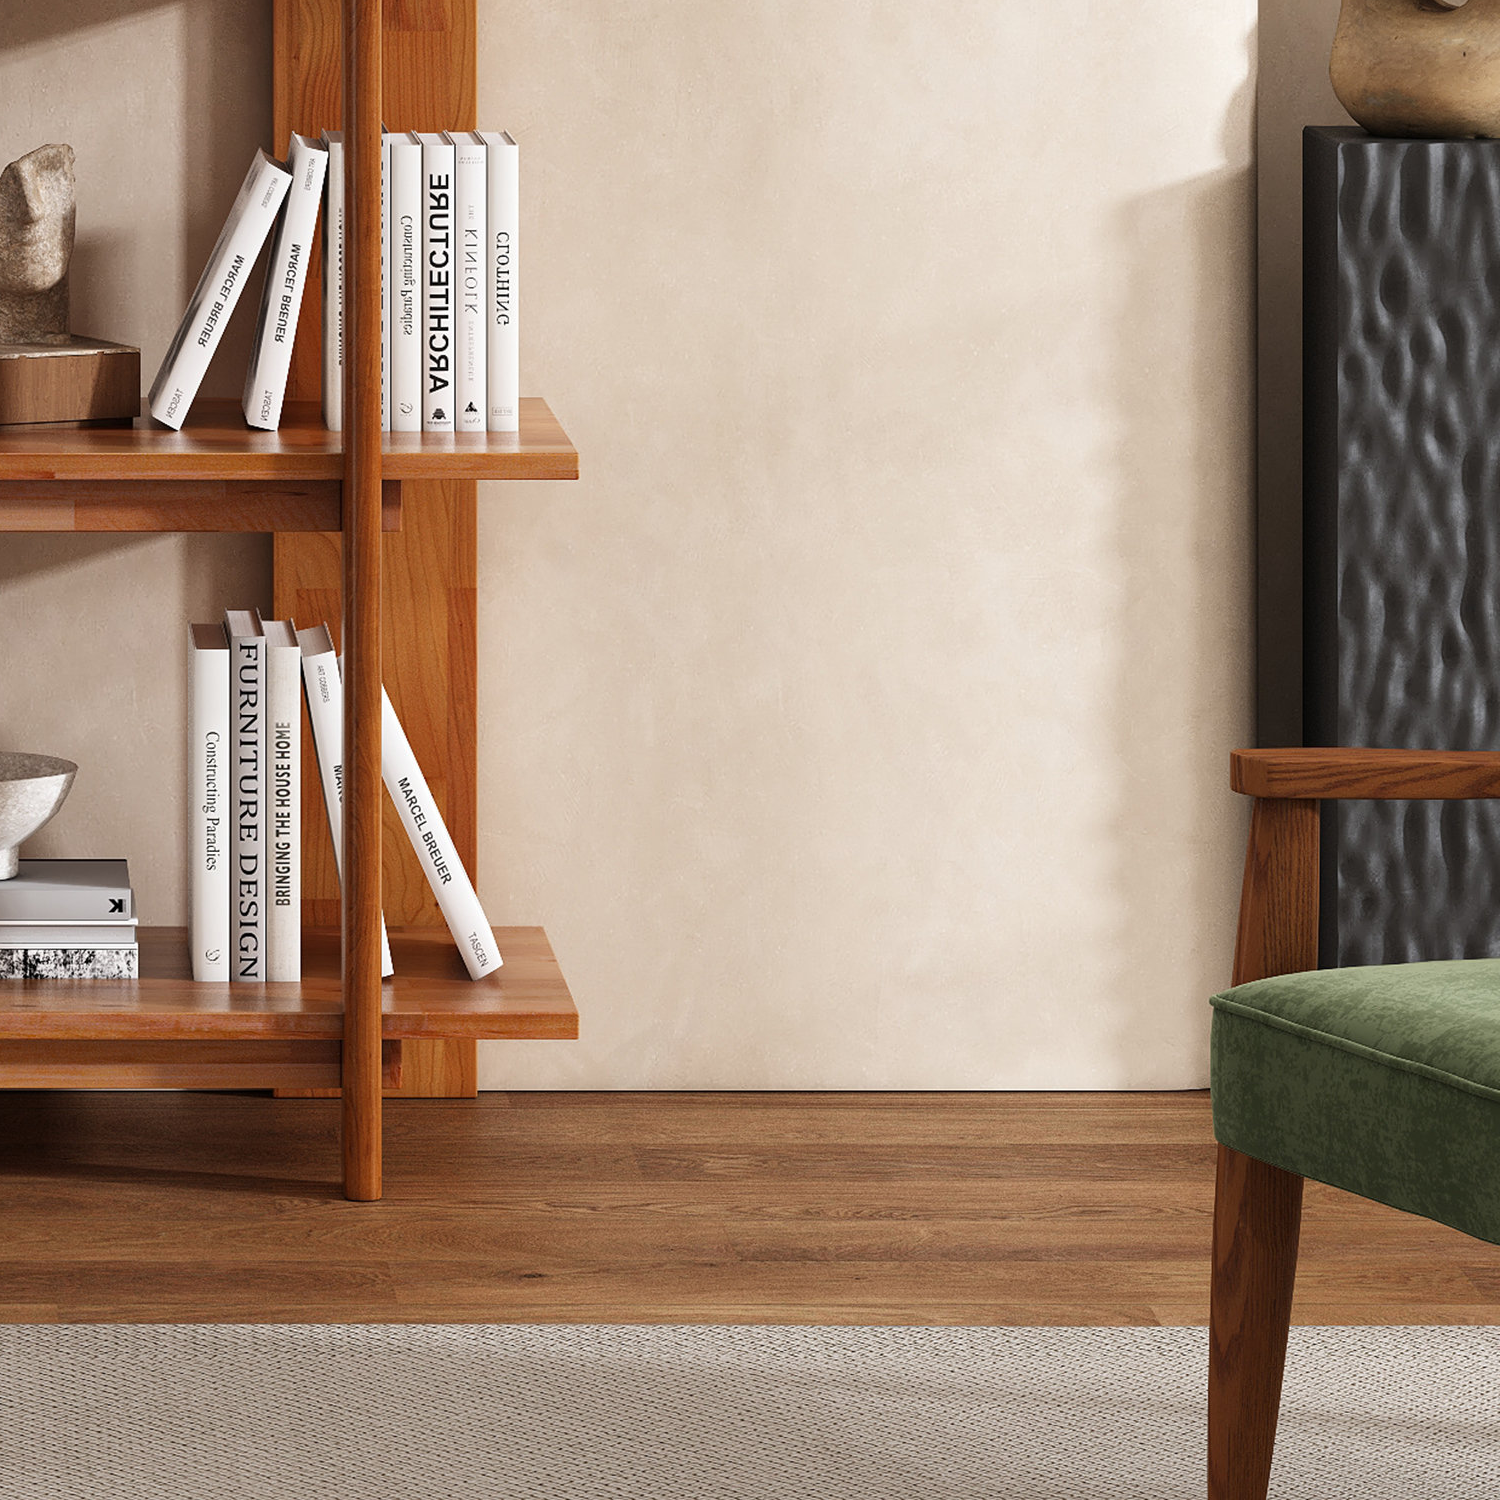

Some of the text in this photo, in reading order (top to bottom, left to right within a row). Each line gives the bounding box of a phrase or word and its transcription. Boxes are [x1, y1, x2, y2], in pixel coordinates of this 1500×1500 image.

[202, 731, 220, 871] Constructing Paradies
[239, 643, 259, 978] FURNITURE DESIGN
[275, 722, 291, 906] BRINGING THE HOUSE HOME
[398, 777, 452, 885] MARCEL BREUER
[468, 931, 489, 968] TASCEN
